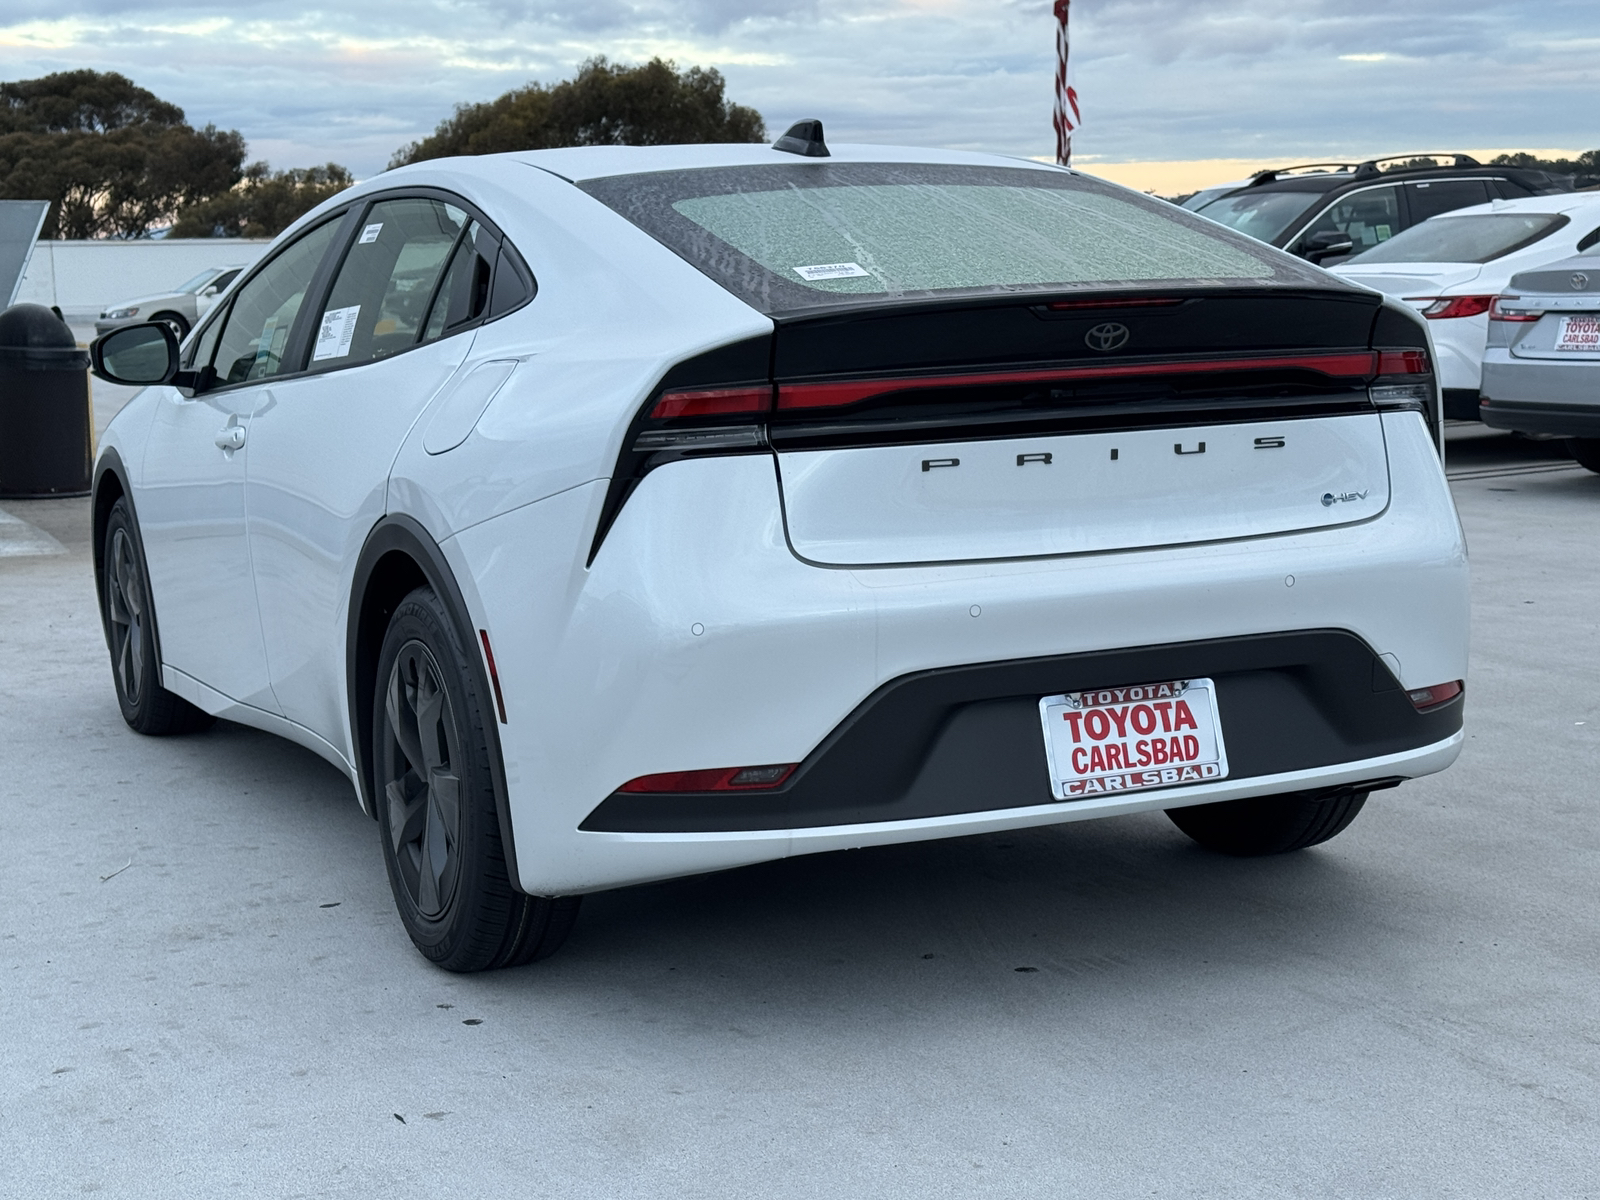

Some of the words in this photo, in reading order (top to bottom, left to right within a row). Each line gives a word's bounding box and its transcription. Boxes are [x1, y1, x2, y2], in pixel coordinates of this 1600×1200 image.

[1562, 334, 1599, 343] CARLSBAD
[921, 436, 1285, 472] PRIUS
[1083, 684, 1172, 706] TOYOTA
[1063, 700, 1198, 743] TOYOTA
[1071, 735, 1199, 775] CARLSBAD
[1063, 763, 1220, 797] CARLSBAD
